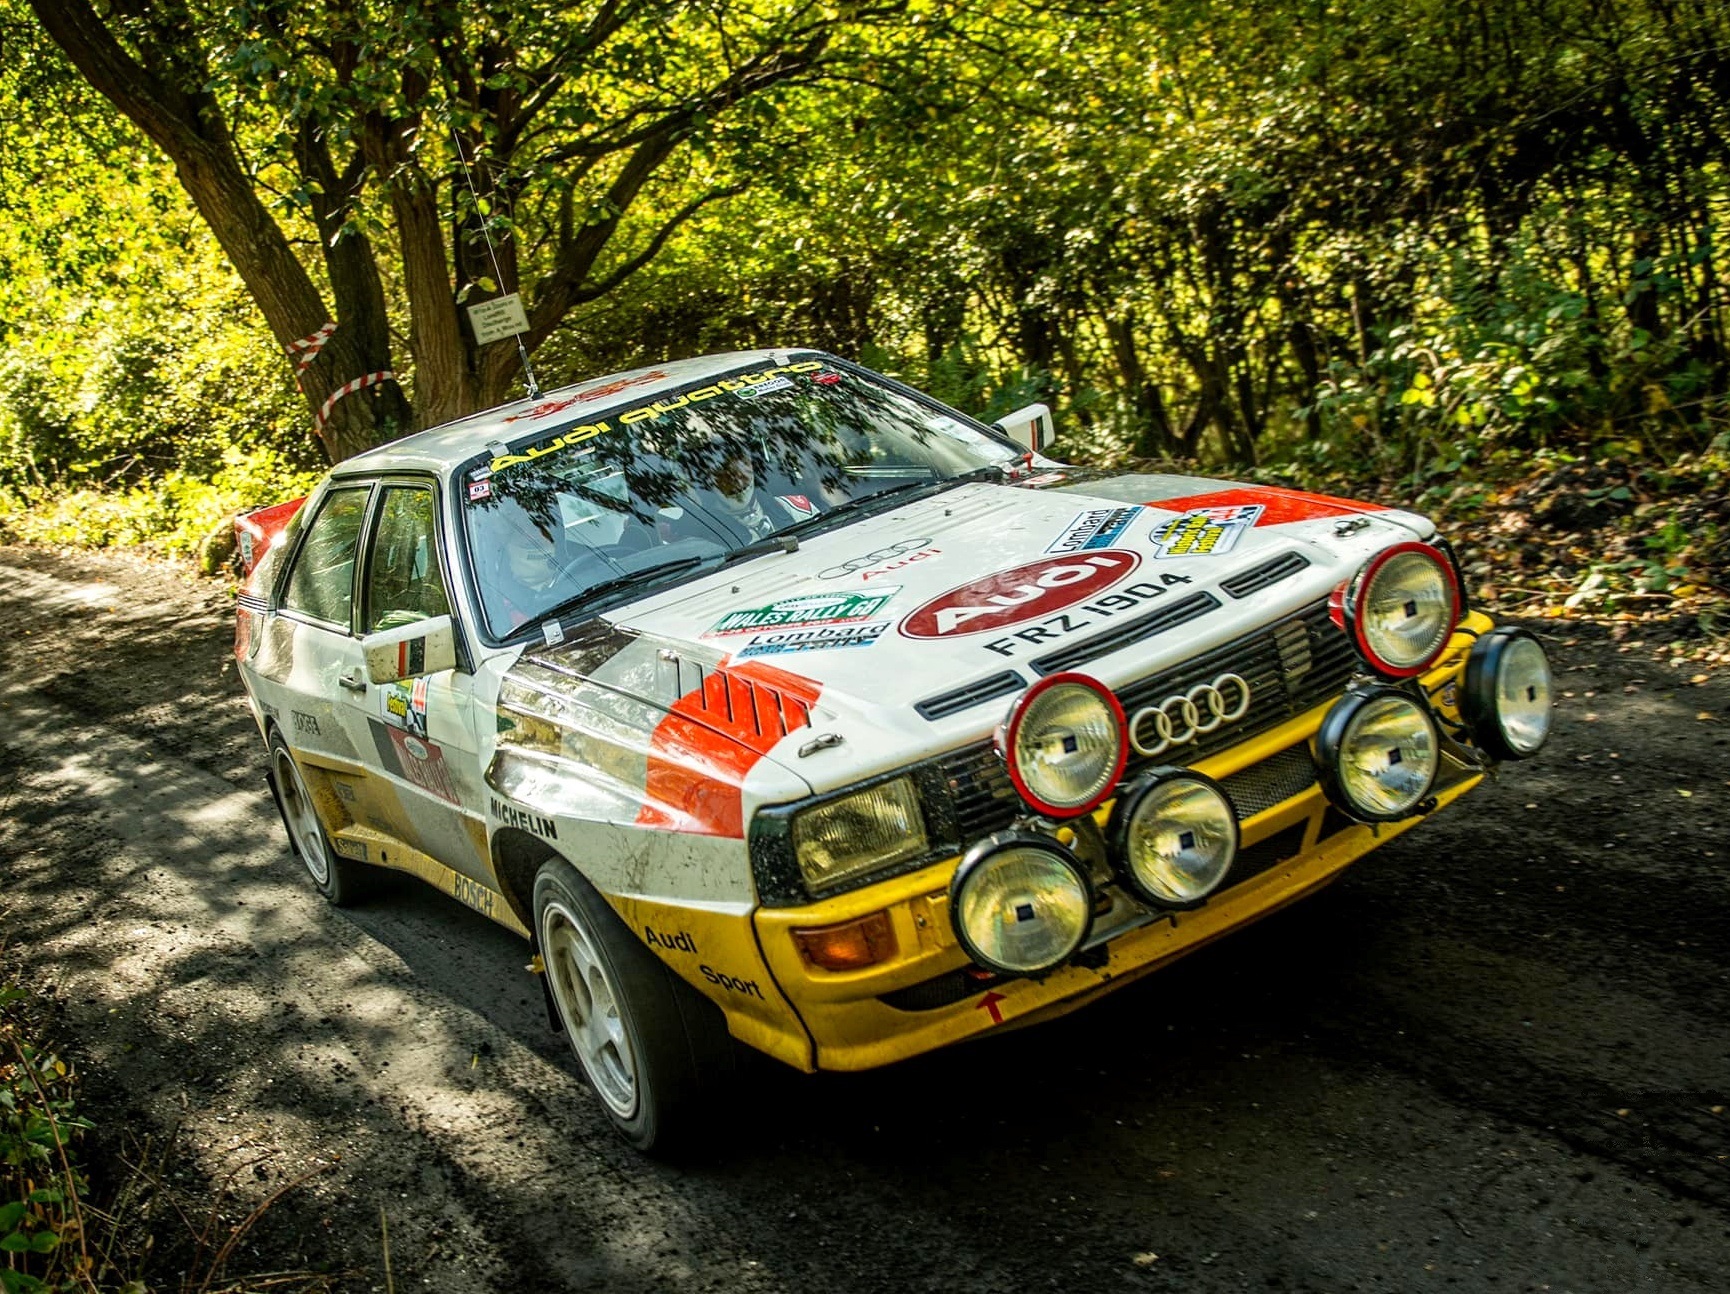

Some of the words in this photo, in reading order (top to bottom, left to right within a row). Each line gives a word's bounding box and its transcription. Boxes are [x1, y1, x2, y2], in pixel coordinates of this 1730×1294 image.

[619, 361, 823, 424] quattro
[1050, 509, 1110, 554] Lombard
[862, 547, 943, 581] Audi
[722, 611, 785, 630] WALES
[788, 604, 849, 623] RALLY
[852, 598, 883, 616] GB
[983, 614, 1090, 657] FRZ
[1086, 573, 1192, 617] 1904
[748, 622, 892, 646] Lombard
[490, 797, 558, 839] MICHELIN
[454, 873, 493, 917] BOSCH
[645, 925, 698, 953] Audi
[699, 964, 765, 1000] Sport
